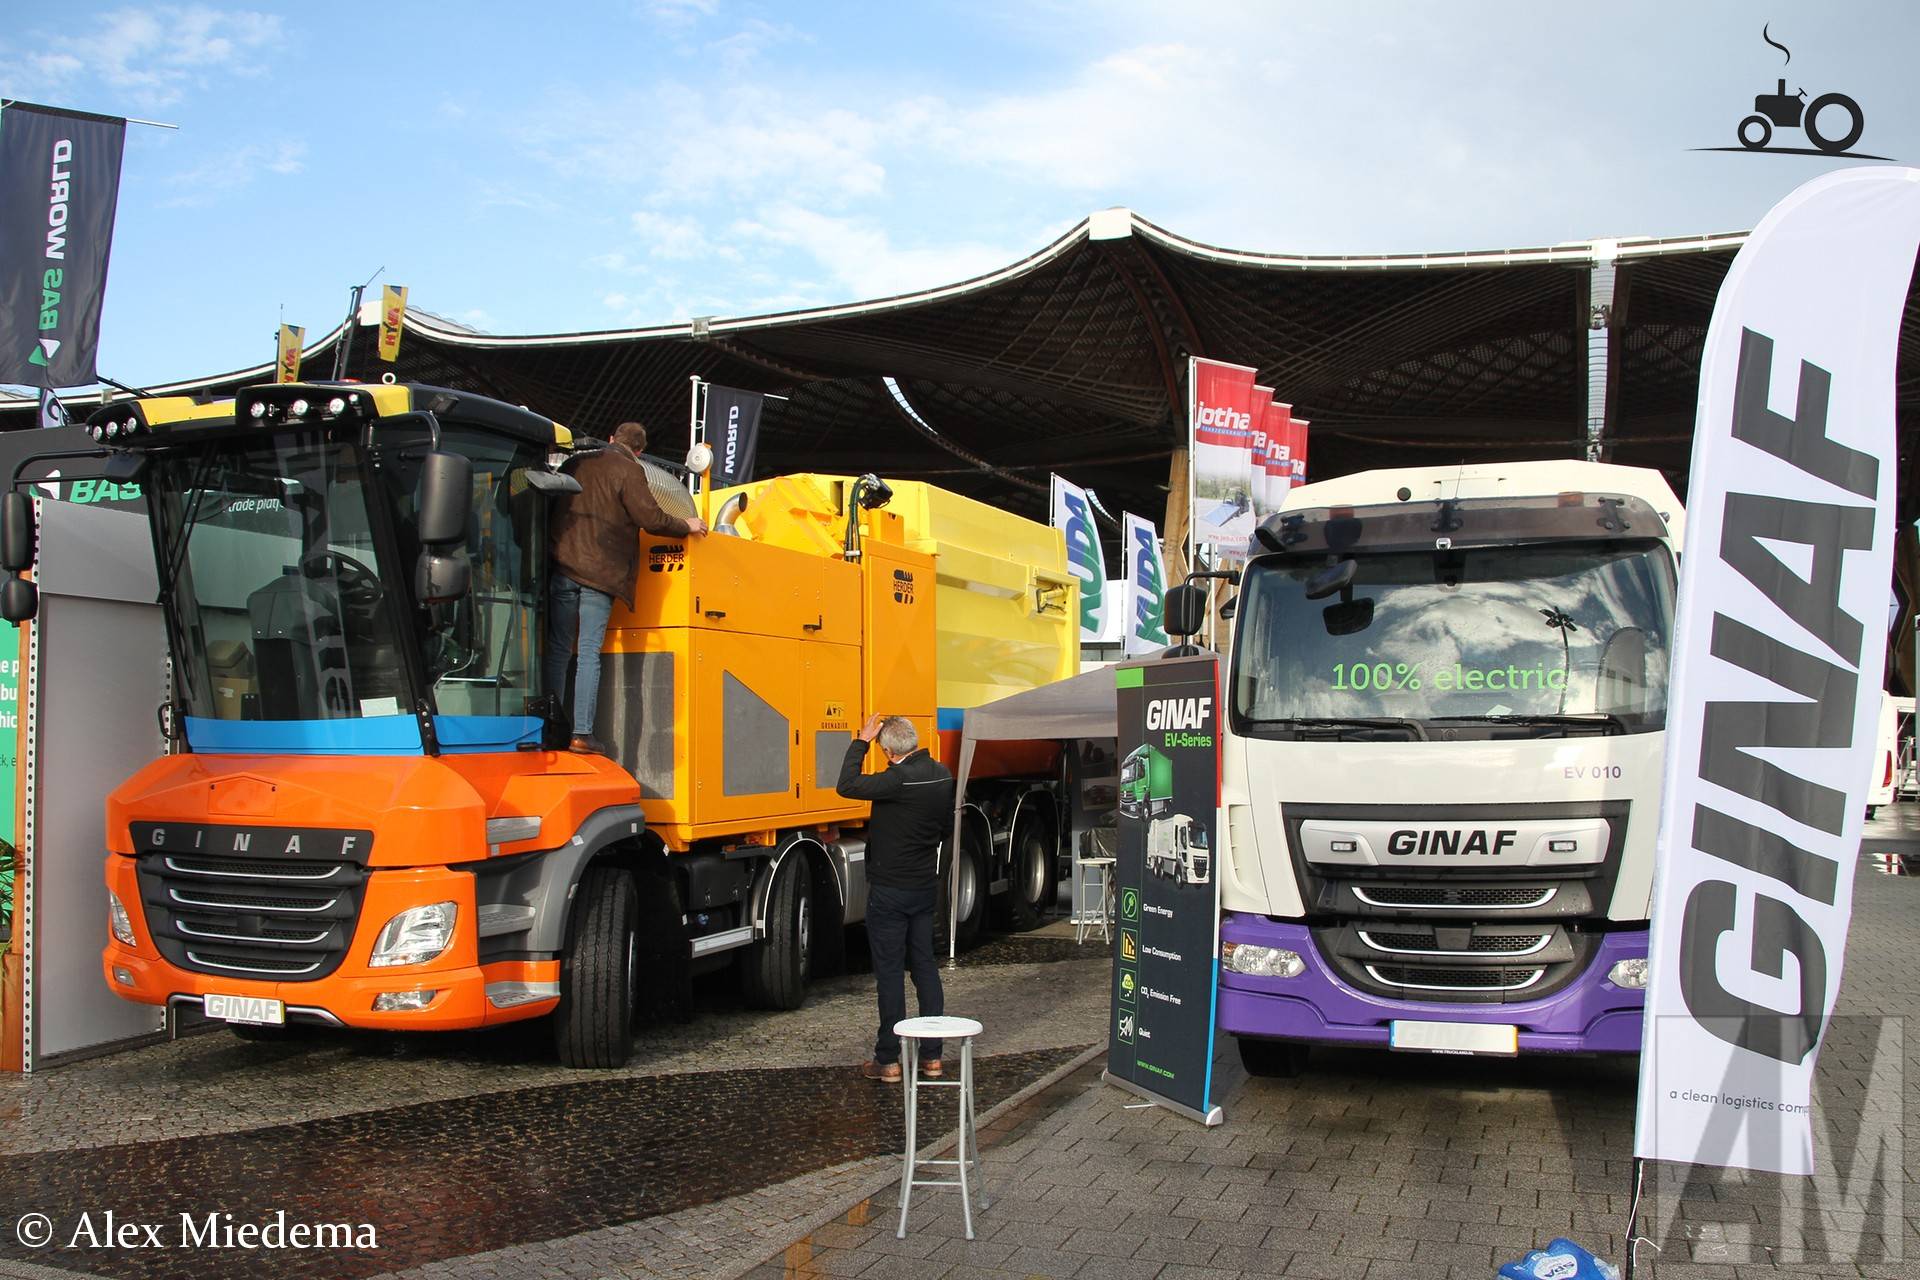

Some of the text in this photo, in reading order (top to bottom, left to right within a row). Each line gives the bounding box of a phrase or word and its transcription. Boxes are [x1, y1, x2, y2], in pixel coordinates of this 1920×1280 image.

[384, 307, 400, 347] HYVA
[1195, 401, 1251, 430] jotha
[69, 480, 142, 503] BAS
[649, 553, 685, 564] HERDER
[893, 579, 914, 594] HERDER
[1133, 526, 1169, 647] KUDA
[1331, 662, 1568, 691] 100% electric
[1679, 326, 1880, 1066] GINAF
[1146, 697, 1212, 731] GINAF
[1164, 732, 1212, 747] EV-Series
[1563, 765, 1622, 780] EV 010
[152, 828, 357, 855] GINAF
[1387, 829, 1518, 856] GINAF
[1143, 903, 1174, 918] Green Energy
[1142, 944, 1182, 961] Low Consumption
[207, 996, 279, 1020] GINAF
[1150, 988, 1169, 1002] Emission
[1169, 994, 1182, 1005] Free
[1138, 1027, 1151, 1039] Quiet
[1669, 1090, 1678, 1099] a
[1681, 1088, 1718, 1104] clean
[1722, 1093, 1774, 1110] logistics
